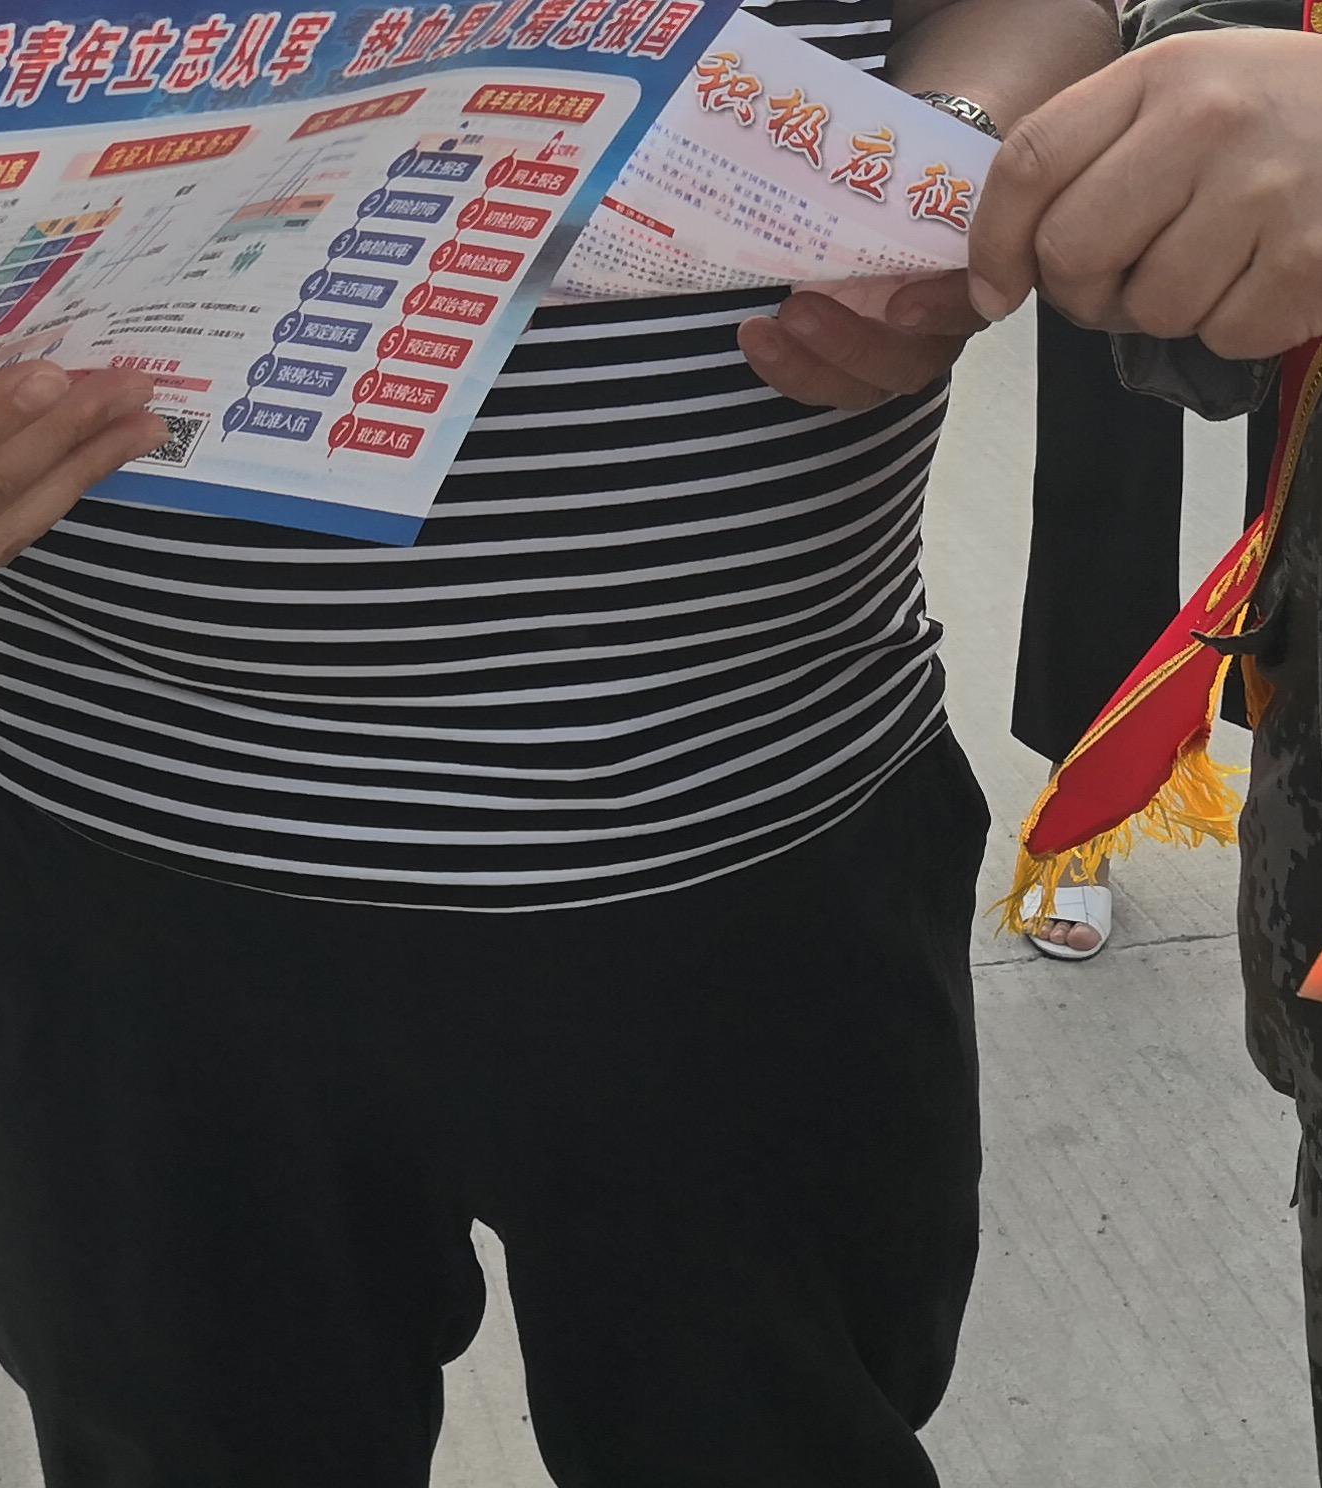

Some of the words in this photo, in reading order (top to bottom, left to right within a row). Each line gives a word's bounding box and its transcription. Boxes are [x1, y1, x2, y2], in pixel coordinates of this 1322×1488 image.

[476, 90, 596, 119] 青年应征入伍流程
[105, 132, 239, 169] 应征入伍基本条件
[694, 51, 975, 231] 积极应征
[412, 158, 470, 178] 网上报名
[511, 169, 567, 191] 网上报名
[385, 199, 442, 218] 初检初审
[484, 210, 539, 233] 初检初审
[327, 280, 385, 302] 走访调查
[428, 294, 486, 319] 政治考核
[300, 321, 359, 345] 预定新兵
[404, 338, 462, 362] 预定新兵
[276, 364, 334, 389] 张榜公示
[379, 381, 436, 406] 张榜公示
[250, 409, 311, 434] 批准入伍
[355, 426, 413, 451] 批准入伍
